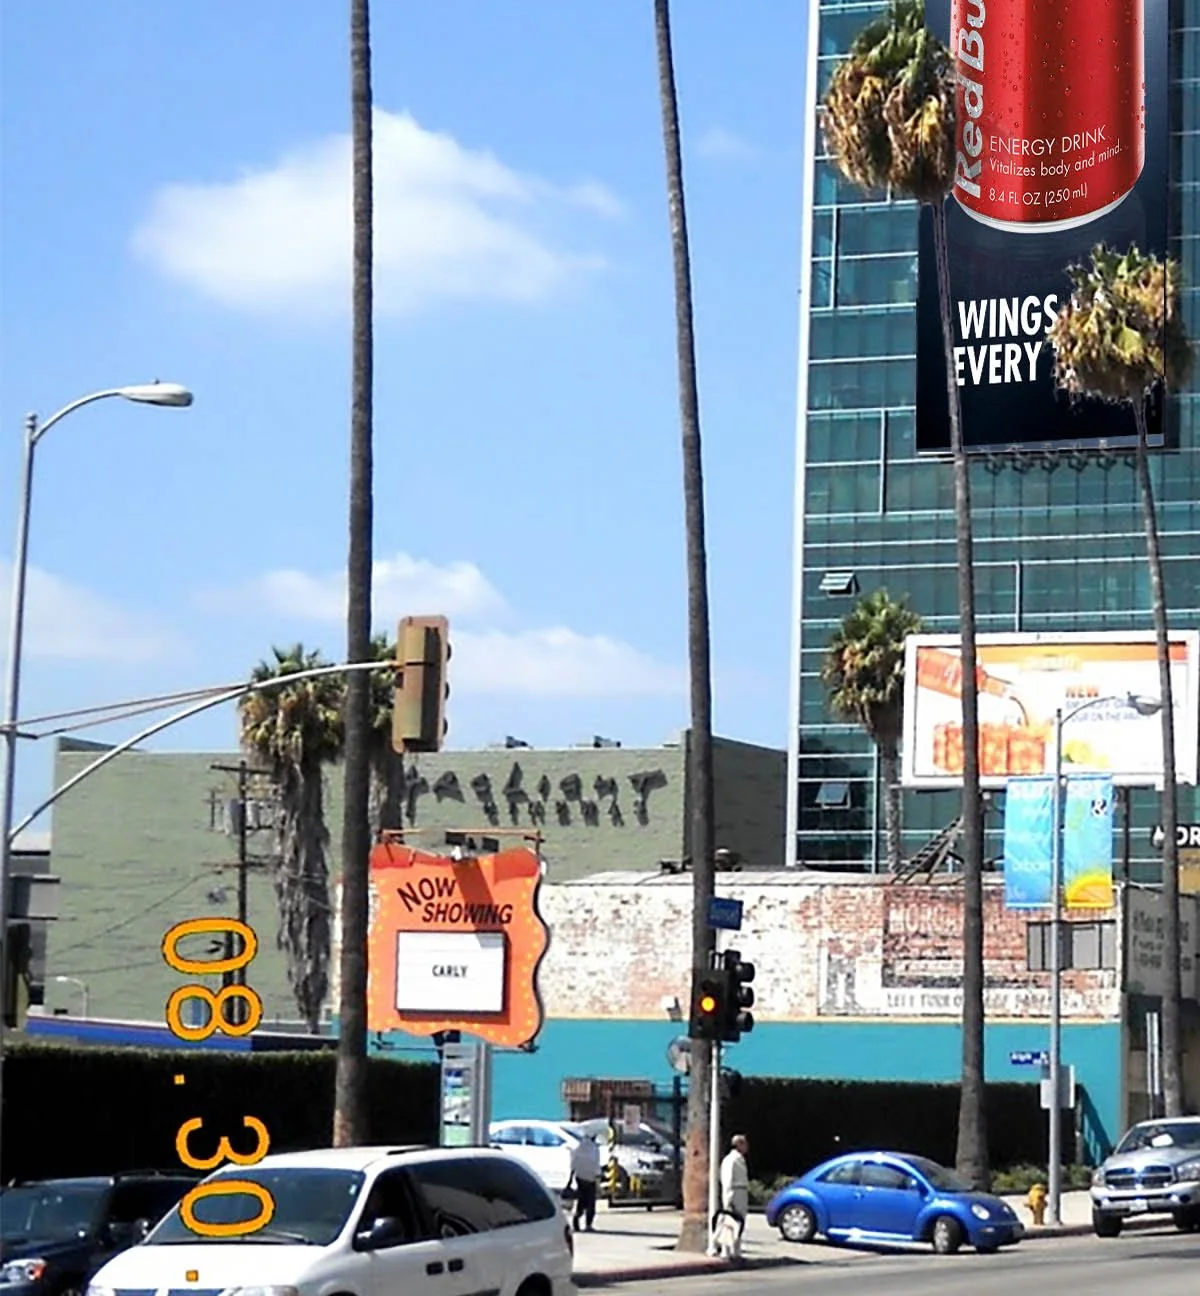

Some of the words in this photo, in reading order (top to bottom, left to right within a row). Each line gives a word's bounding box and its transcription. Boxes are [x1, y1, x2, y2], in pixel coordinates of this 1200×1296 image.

[953, 72, 984, 198] Red
[990, 135, 1056, 156] ENERGY
[1062, 124, 1106, 153] DRINK
[989, 157, 1036, 176] Vitalizes
[1040, 161, 1070, 177] body
[1074, 154, 1095, 171] and
[1098, 139, 1123, 163] mind.
[989, 188, 1005, 202] 8.4
[1008, 191, 1019, 204] FL
[1022, 192, 1041, 205] OZ
[1045, 188, 1070, 207] (250
[958, 294, 1059, 340] WINGS
[953, 341, 1043, 387] EVERY
[397, 876, 456, 912] NOW
[421, 902, 513, 924] SHOWING
[432, 964, 469, 978] CARLY
